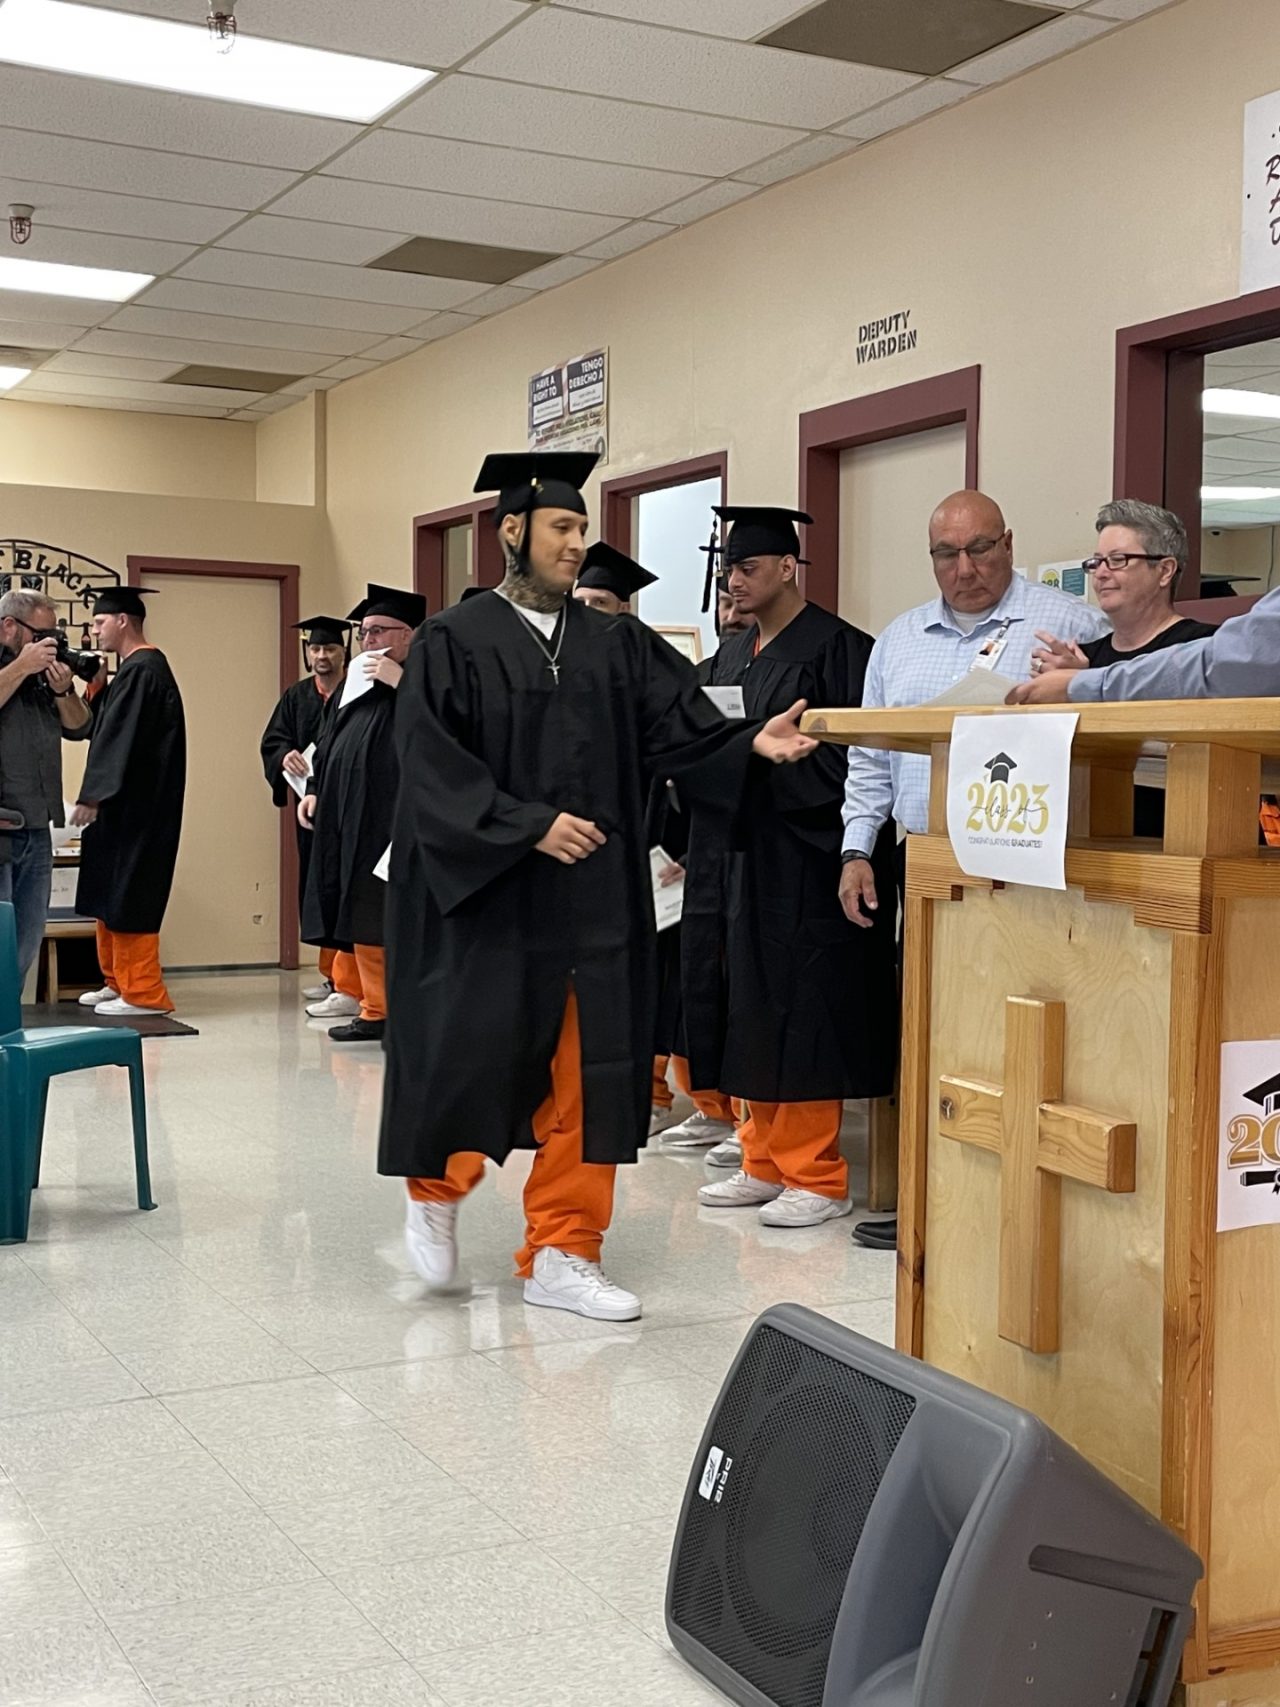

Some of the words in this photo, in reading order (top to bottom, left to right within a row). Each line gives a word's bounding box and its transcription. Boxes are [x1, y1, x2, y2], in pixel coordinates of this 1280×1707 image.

[858, 309, 911, 344] DEPUTY
[856, 329, 917, 365] WARDEN
[581, 357, 603, 373] TENGO
[536, 377, 550, 390] HAVE
[569, 372, 597, 388] DERECHO
[533, 390, 549, 403] RIGHT
[549, 386, 557, 397] TO
[13, 549, 102, 609] BLACK
[966, 782, 1050, 835] 2023
